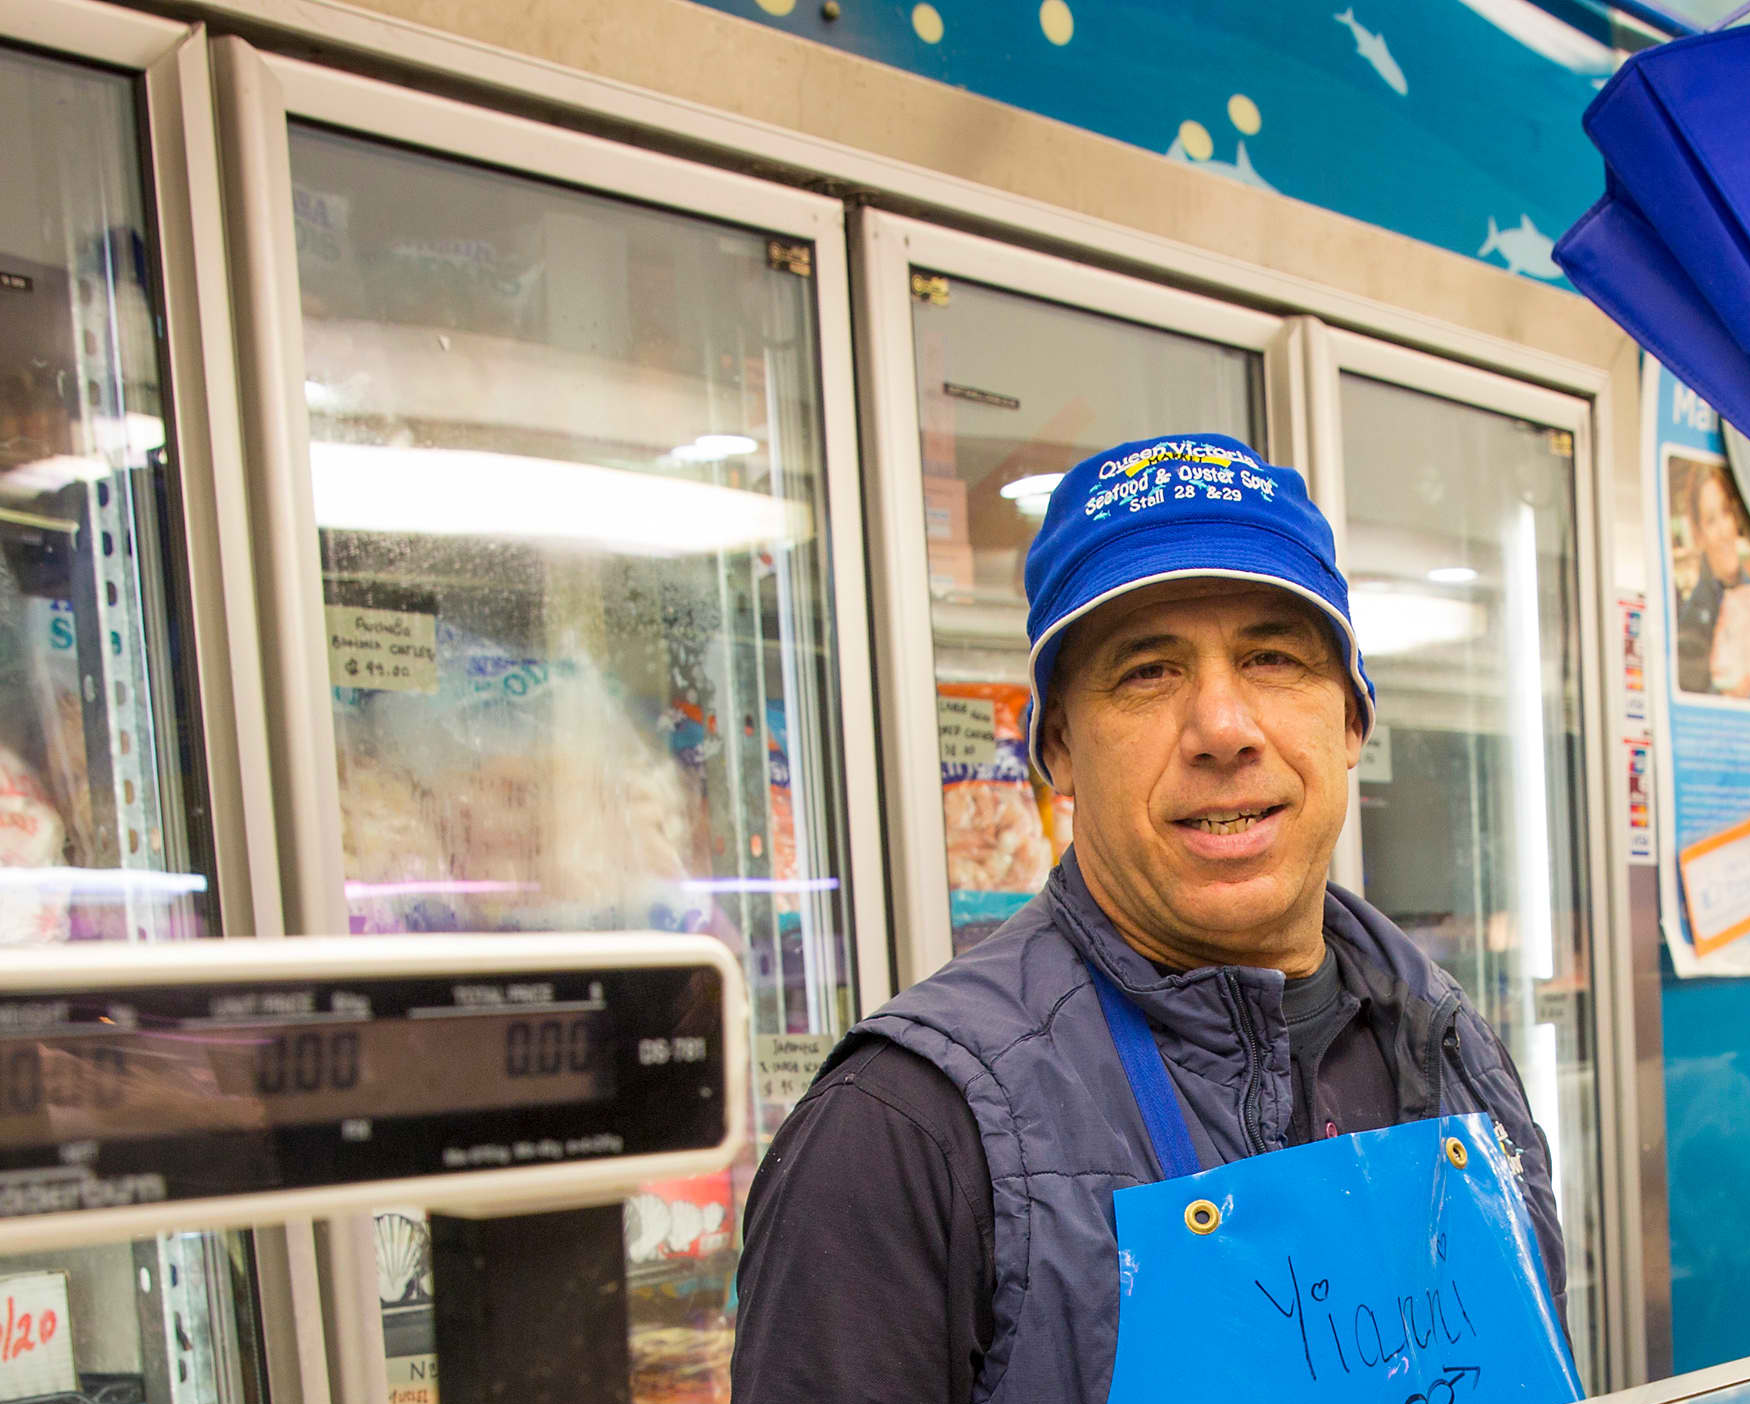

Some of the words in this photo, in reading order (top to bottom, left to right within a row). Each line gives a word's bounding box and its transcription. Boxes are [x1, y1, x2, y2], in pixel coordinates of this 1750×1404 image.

[1671, 382, 1721, 432] Ma
[1098, 446, 1168, 480] Queen
[1168, 441, 1260, 470] Victoria
[1084, 472, 1149, 516] Seafood
[1154, 468, 1172, 485] &
[1178, 465, 1236, 484] Oyster
[1240, 470, 1275, 497] Spot
[1128, 488, 1165, 513] Stall
[1174, 484, 1196, 499] 28
[0, 1295, 57, 1363] /20
